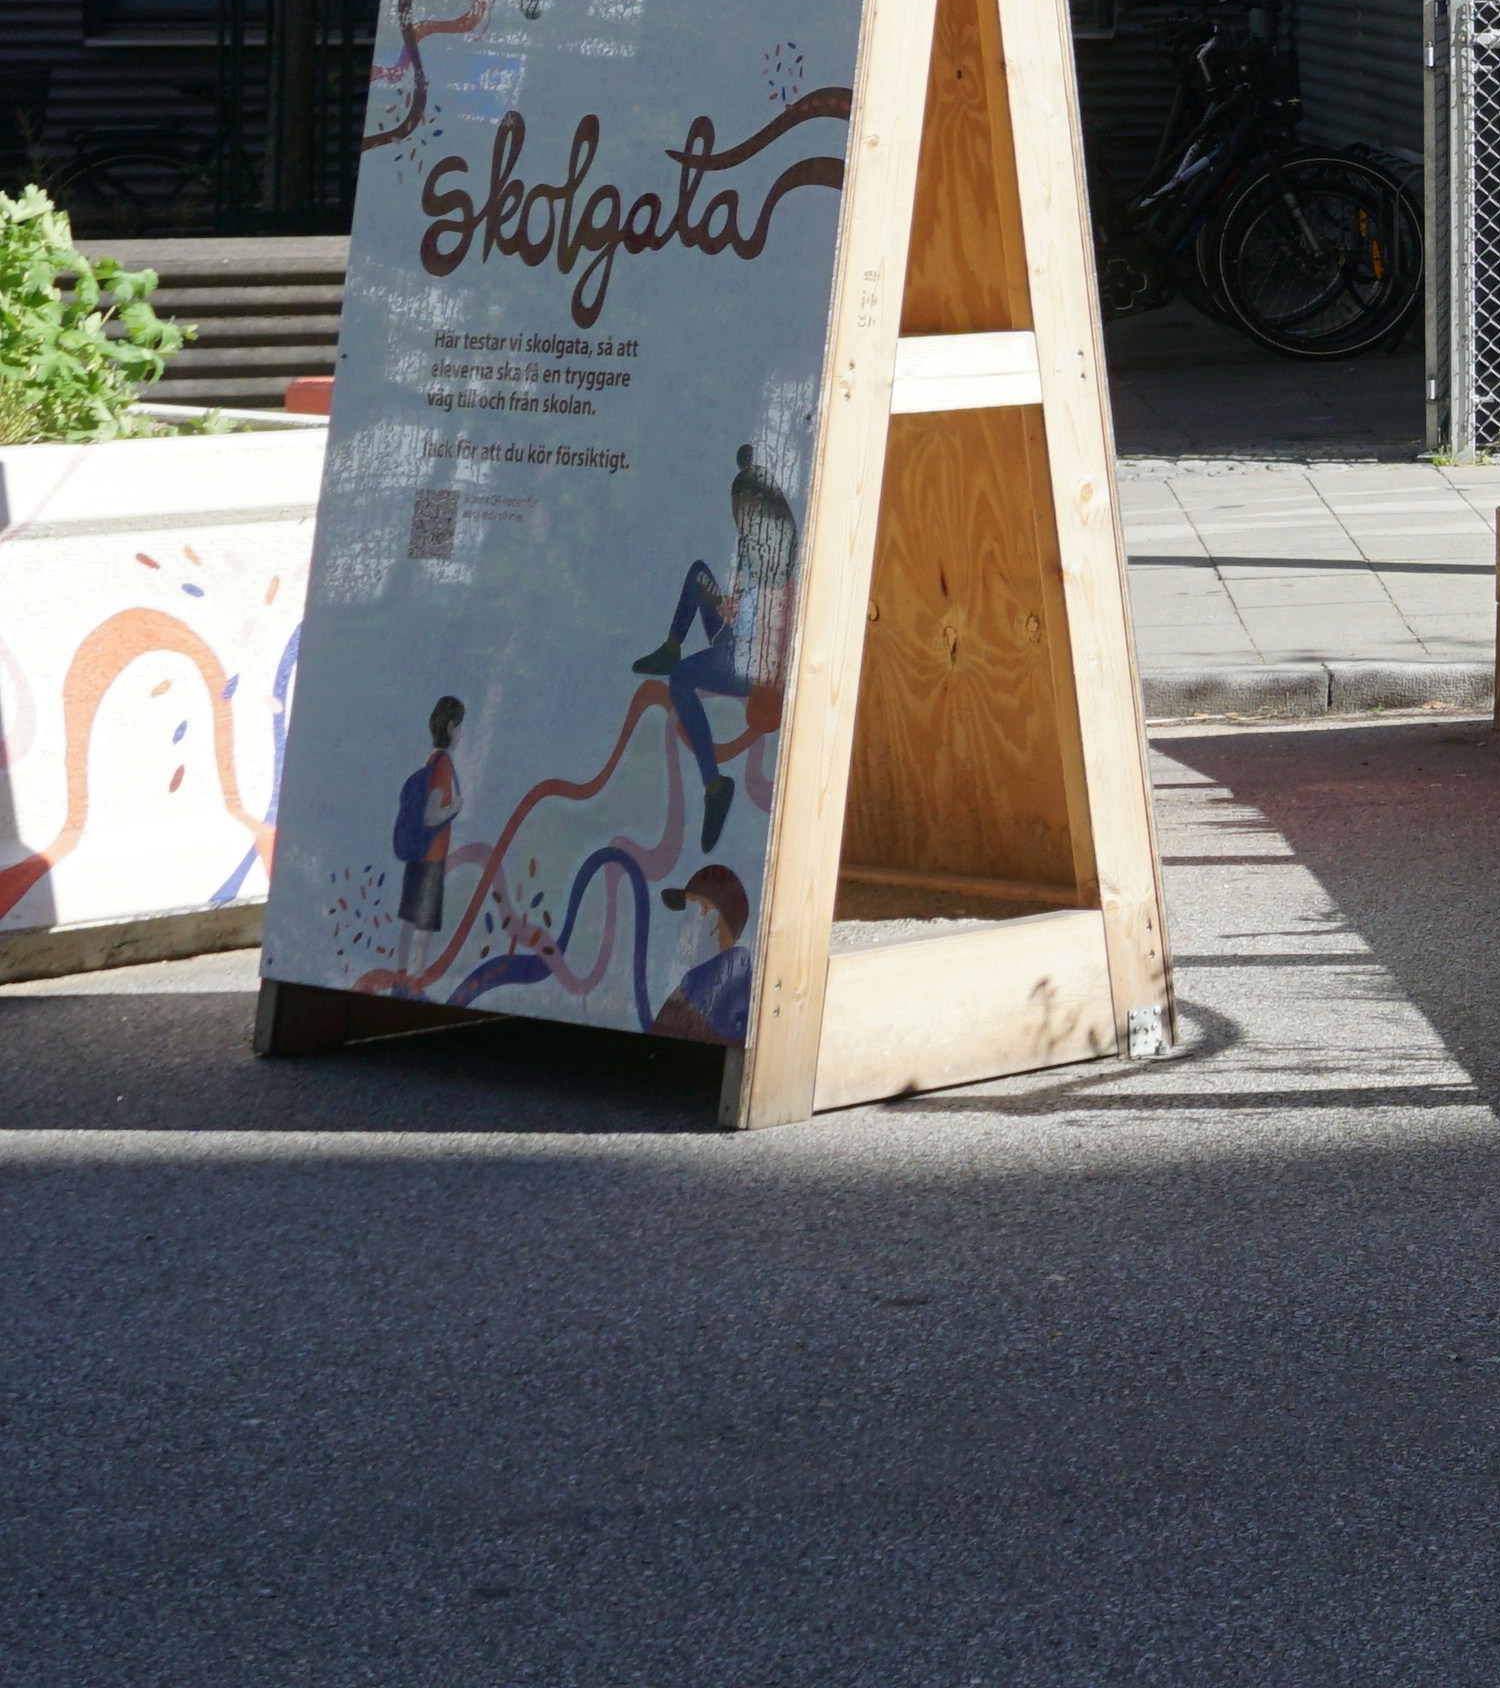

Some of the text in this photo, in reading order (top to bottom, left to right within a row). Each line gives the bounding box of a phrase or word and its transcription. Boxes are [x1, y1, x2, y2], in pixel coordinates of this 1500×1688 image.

[434, 330, 639, 359] Här testar vi skolgata, så att
[431, 359, 631, 391] eleverna ska få en tryggare
[427, 387, 596, 415] väg till och från skolan.
[457, 439, 478, 459] för
[481, 443, 502, 461] att
[505, 442, 523, 462] du
[528, 443, 552, 465] kör
[555, 445, 630, 474] försiktigt.
